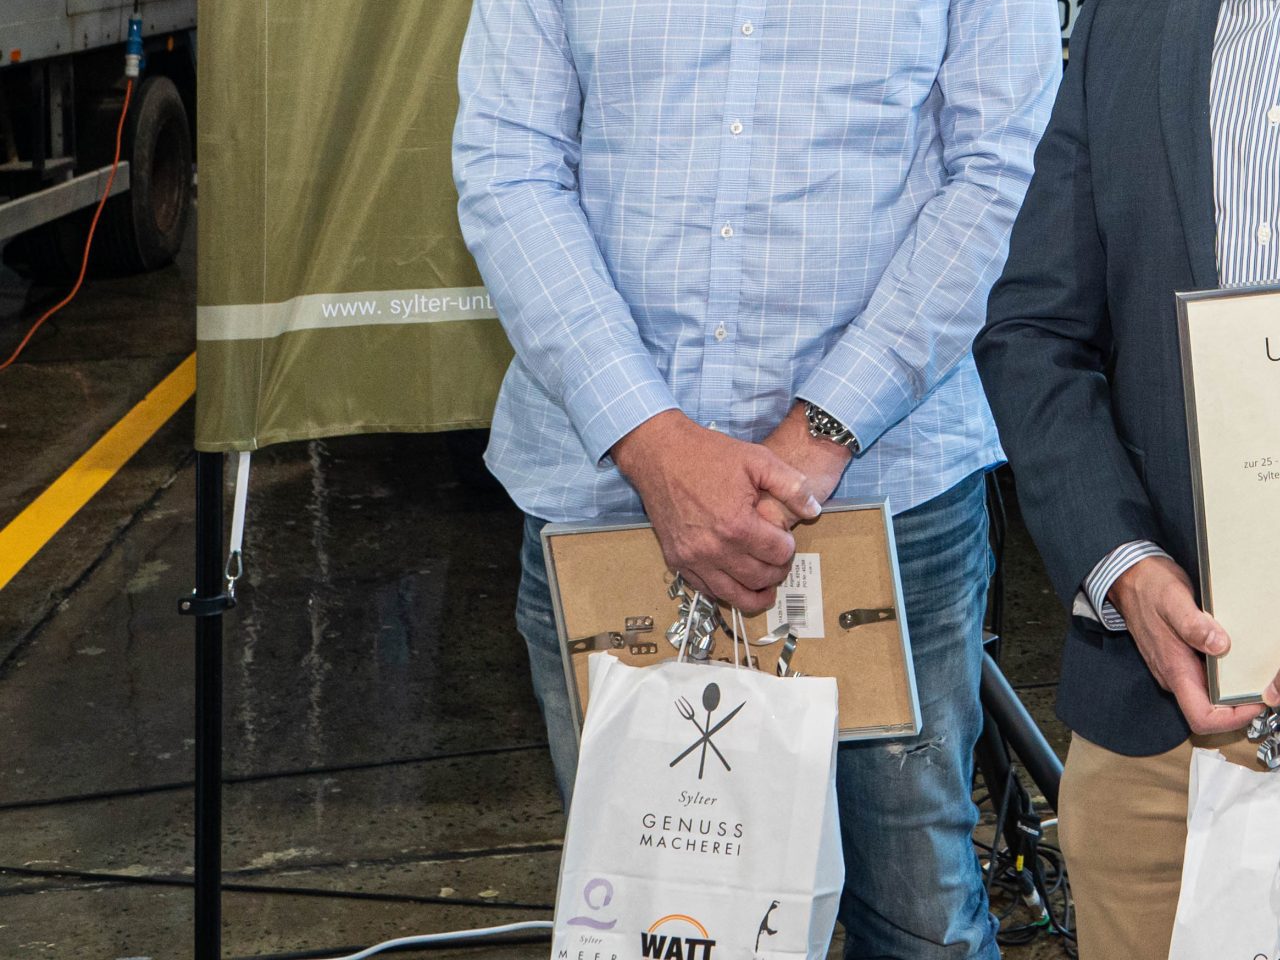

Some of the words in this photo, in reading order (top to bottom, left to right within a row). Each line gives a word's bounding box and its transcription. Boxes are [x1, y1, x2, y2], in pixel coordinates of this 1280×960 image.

[1243, 459, 1258, 469] zur
[1261, 457, 1273, 467] 25
[678, 790, 718, 807] Sylter
[642, 813, 743, 839] GENUSS
[640, 834, 741, 856] MACHEREI
[641, 932, 716, 960] WATT
